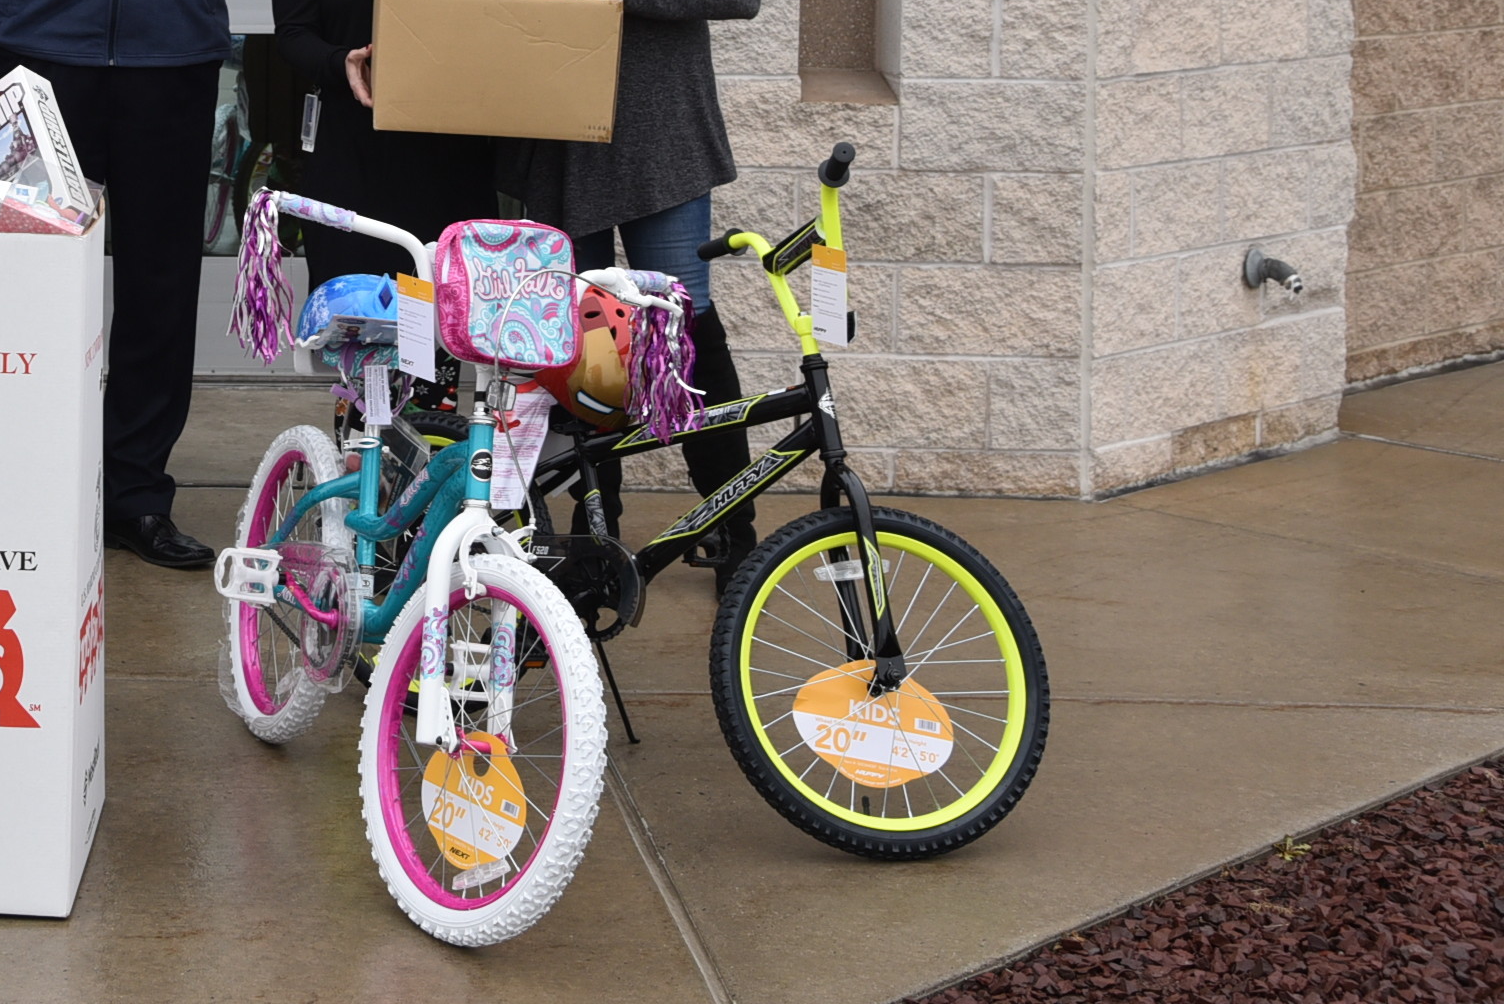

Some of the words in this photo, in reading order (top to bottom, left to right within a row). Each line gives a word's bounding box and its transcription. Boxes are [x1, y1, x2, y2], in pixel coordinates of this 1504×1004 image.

[38, 100, 88, 207] BATTLESHIP
[473, 257, 516, 300] Girl
[713, 459, 766, 511] HUFFY
[29, 703, 42, 713] SM
[848, 698, 902, 727] KIDS
[814, 723, 868, 753] 20"
[457, 775, 495, 806] KIDS
[449, 847, 471, 860] NEXT
